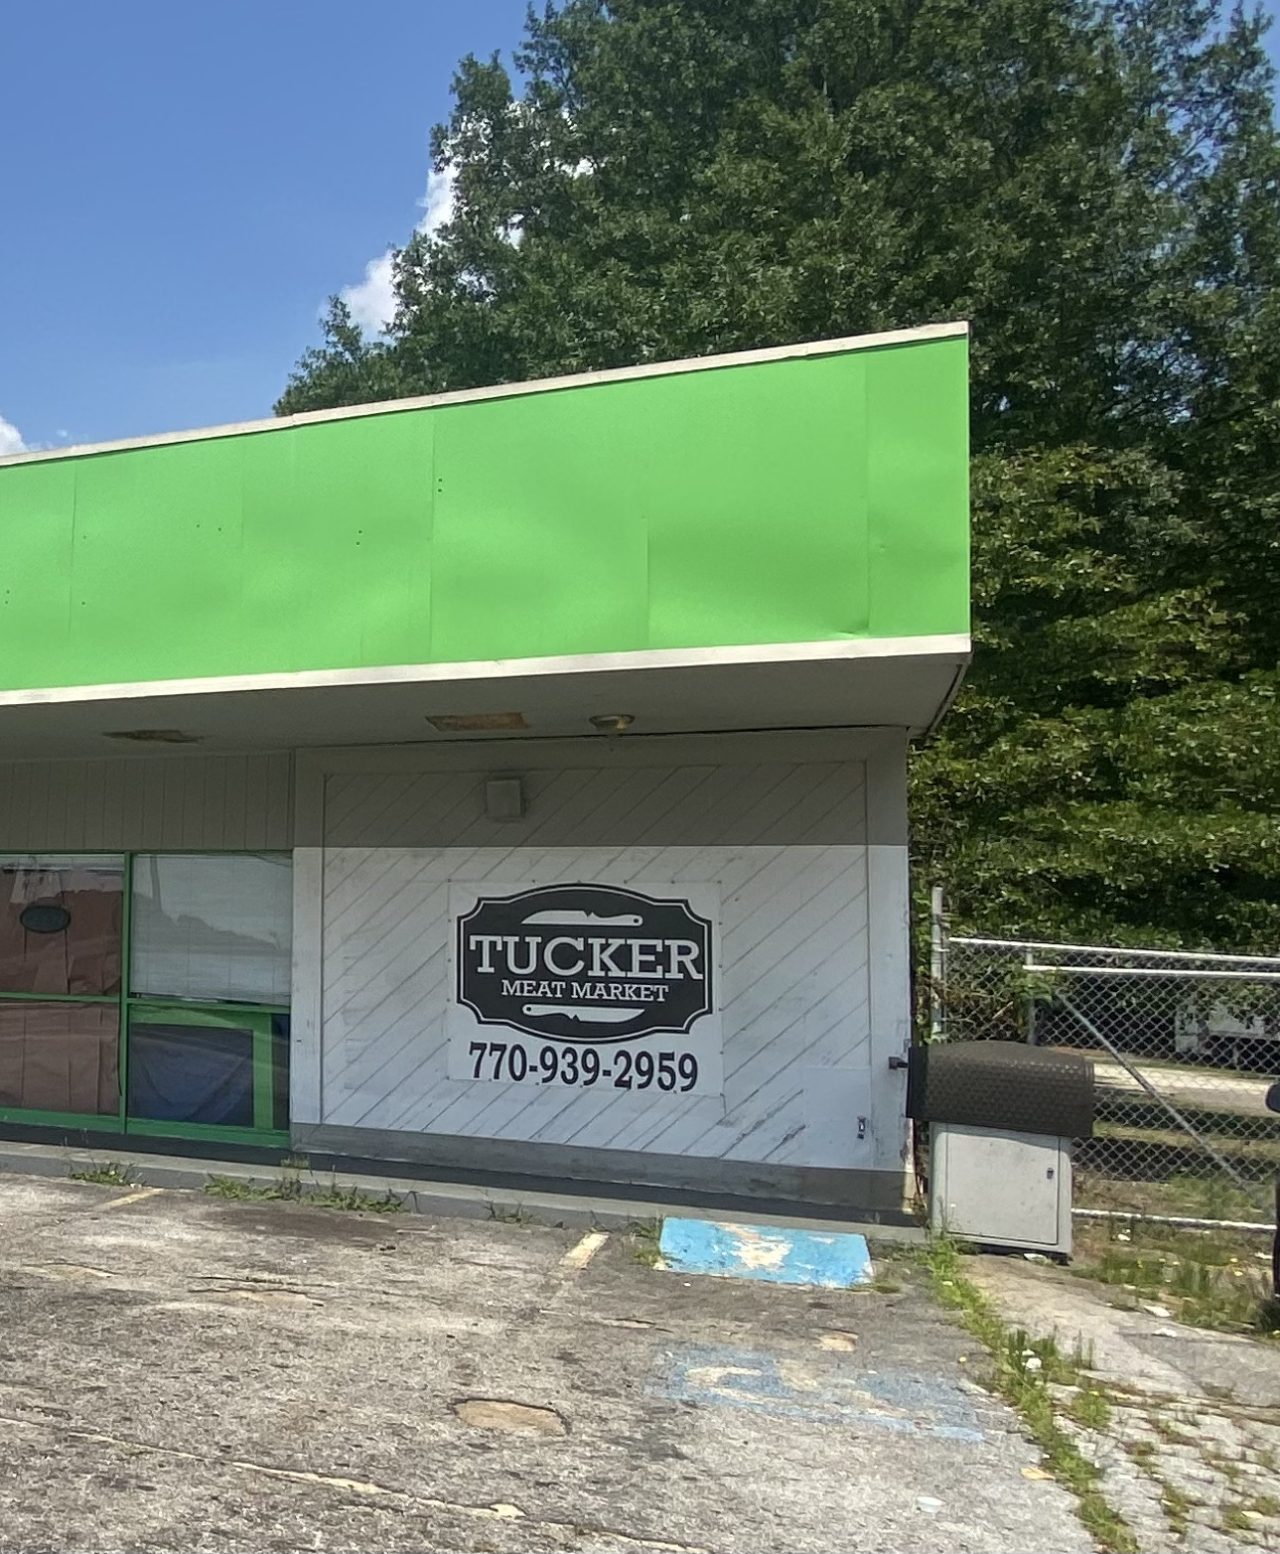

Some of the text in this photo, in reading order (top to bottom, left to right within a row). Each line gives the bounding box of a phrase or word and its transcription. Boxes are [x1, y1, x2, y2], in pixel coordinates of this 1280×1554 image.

[469, 935, 703, 980] TUCKER
[501, 979, 669, 1002] MEAT MARKET
[469, 1041, 698, 1092] 770-939-2959
